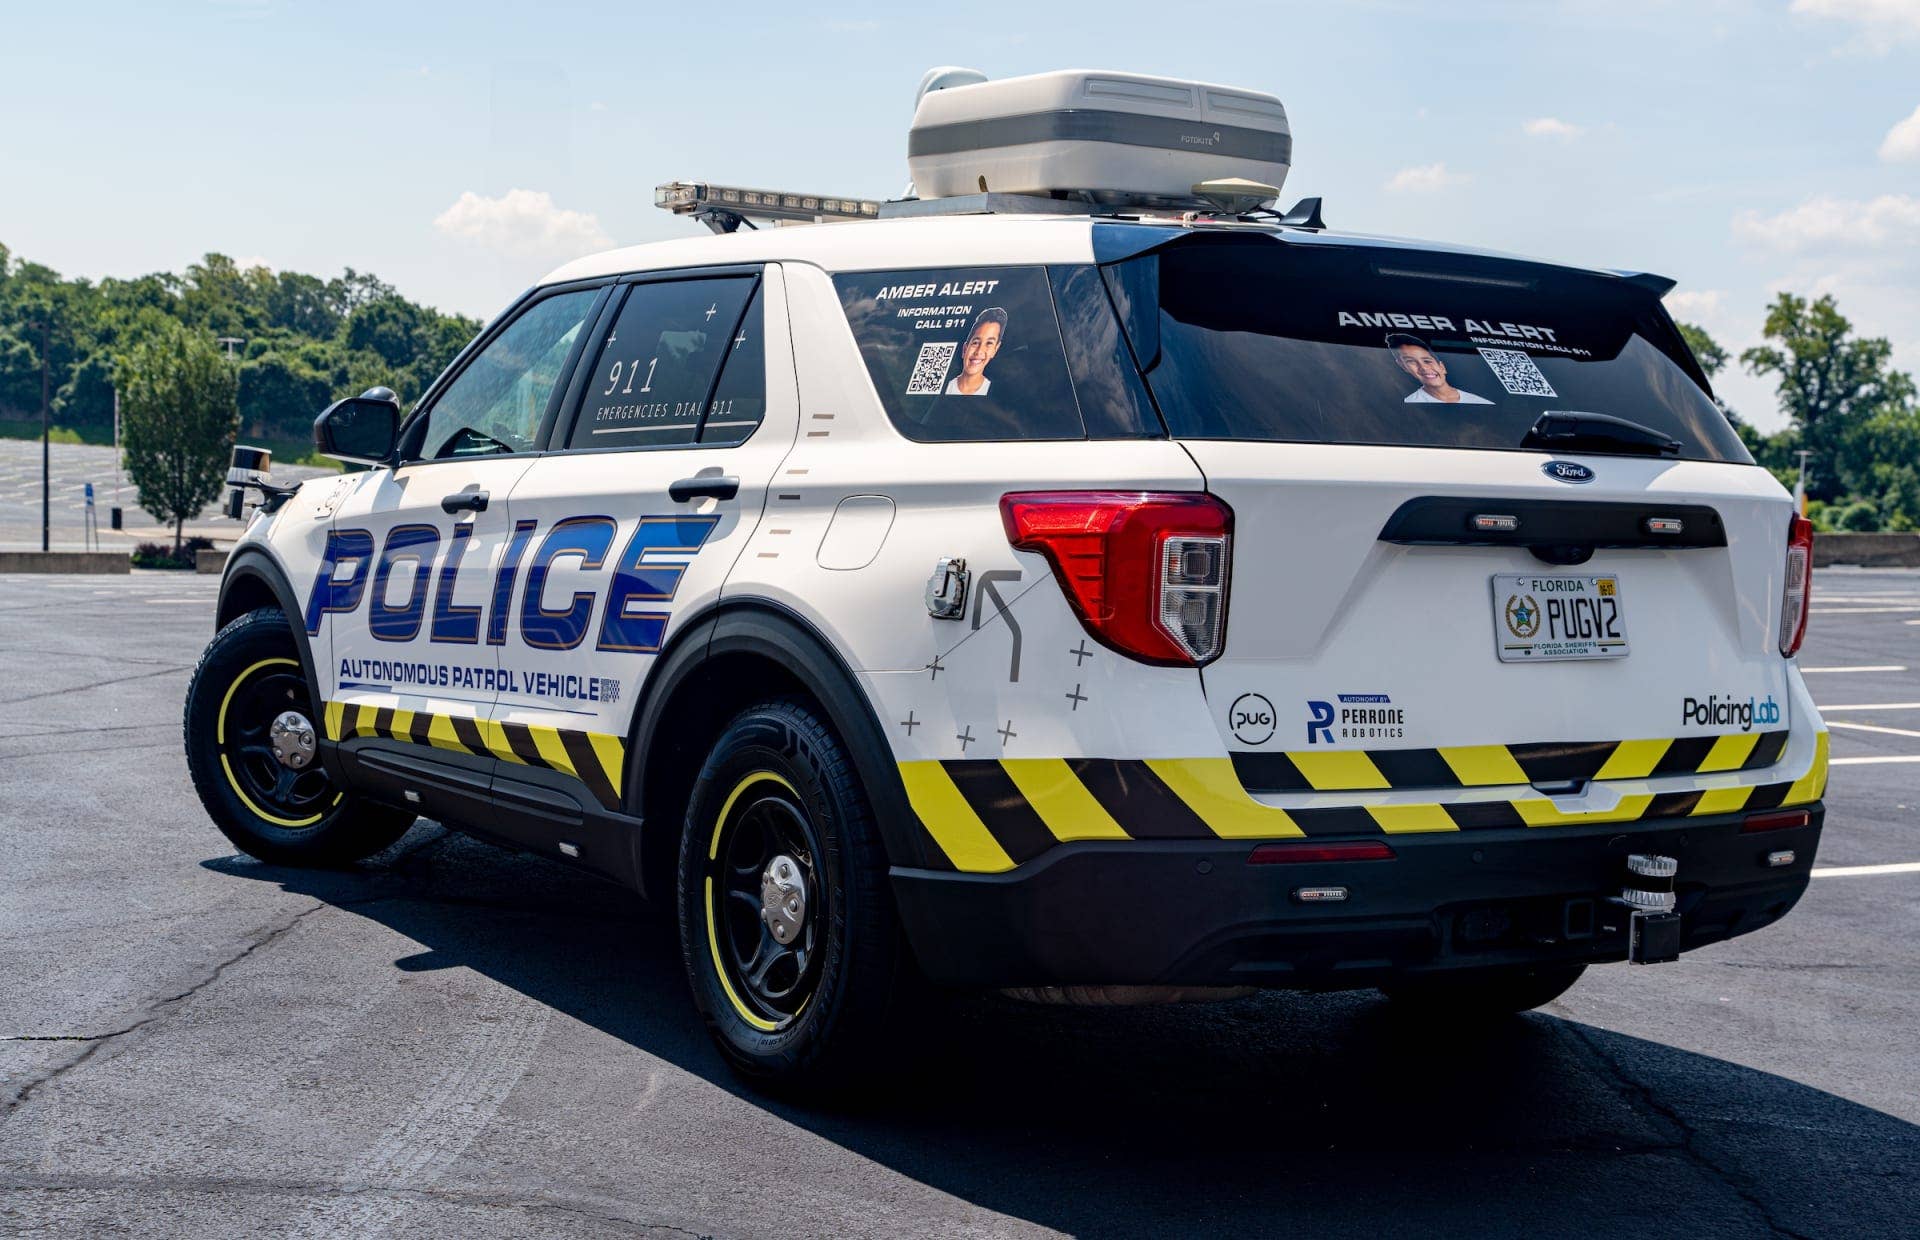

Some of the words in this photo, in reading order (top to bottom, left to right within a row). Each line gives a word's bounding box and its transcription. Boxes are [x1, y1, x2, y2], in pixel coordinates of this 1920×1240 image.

[1181, 135, 1213, 146] FOTOKITE
[876, 284, 937, 300] AMBER
[938, 280, 999, 296] ALERT
[897, 305, 972, 317] INFORMATION
[915, 320, 942, 329] CALL
[945, 319, 966, 328] 911
[1338, 311, 1457, 331] AMBER
[1465, 318, 1556, 342] ALERT
[1470, 336, 1545, 350] INFORMATION
[1545, 344, 1571, 354] CALL
[604, 357, 658, 395] 911
[597, 403, 668, 421] EMERGENCIES
[674, 401, 702, 416] DIAL
[711, 400, 733, 415] 911
[1556, 464, 1586, 477] Ford
[305, 514, 722, 655] POLICE
[1532, 580, 1584, 592] FLORIDA
[1547, 598, 1621, 640] PUGV2
[340, 658, 448, 687] AUTONOMOUS
[452, 665, 519, 693] PATROL
[524, 672, 600, 702] VEHICLE
[1342, 709, 1404, 724] PERRONE
[1683, 694, 1779, 731] PolicingLab
[1342, 728, 1403, 738] ROBOTICS
